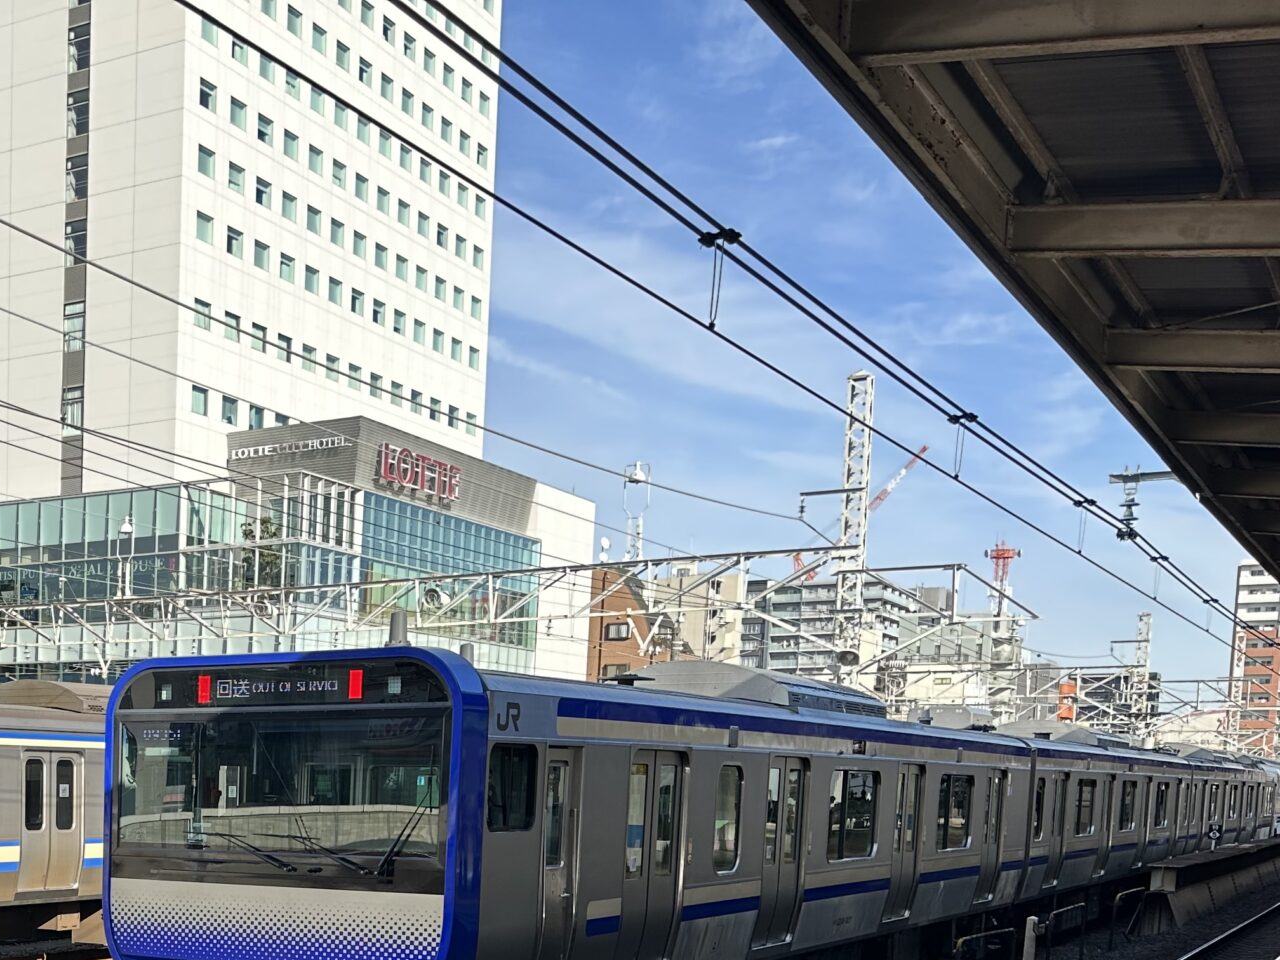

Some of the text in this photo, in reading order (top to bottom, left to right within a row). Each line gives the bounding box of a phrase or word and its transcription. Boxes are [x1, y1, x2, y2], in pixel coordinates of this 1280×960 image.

[232, 443, 278, 460] LOTTE
[308, 436, 353, 450] HOTEL
[381, 441, 463, 501] LOTTE
[217, 679, 250, 698] 回送
[496, 702, 520, 732] JR
